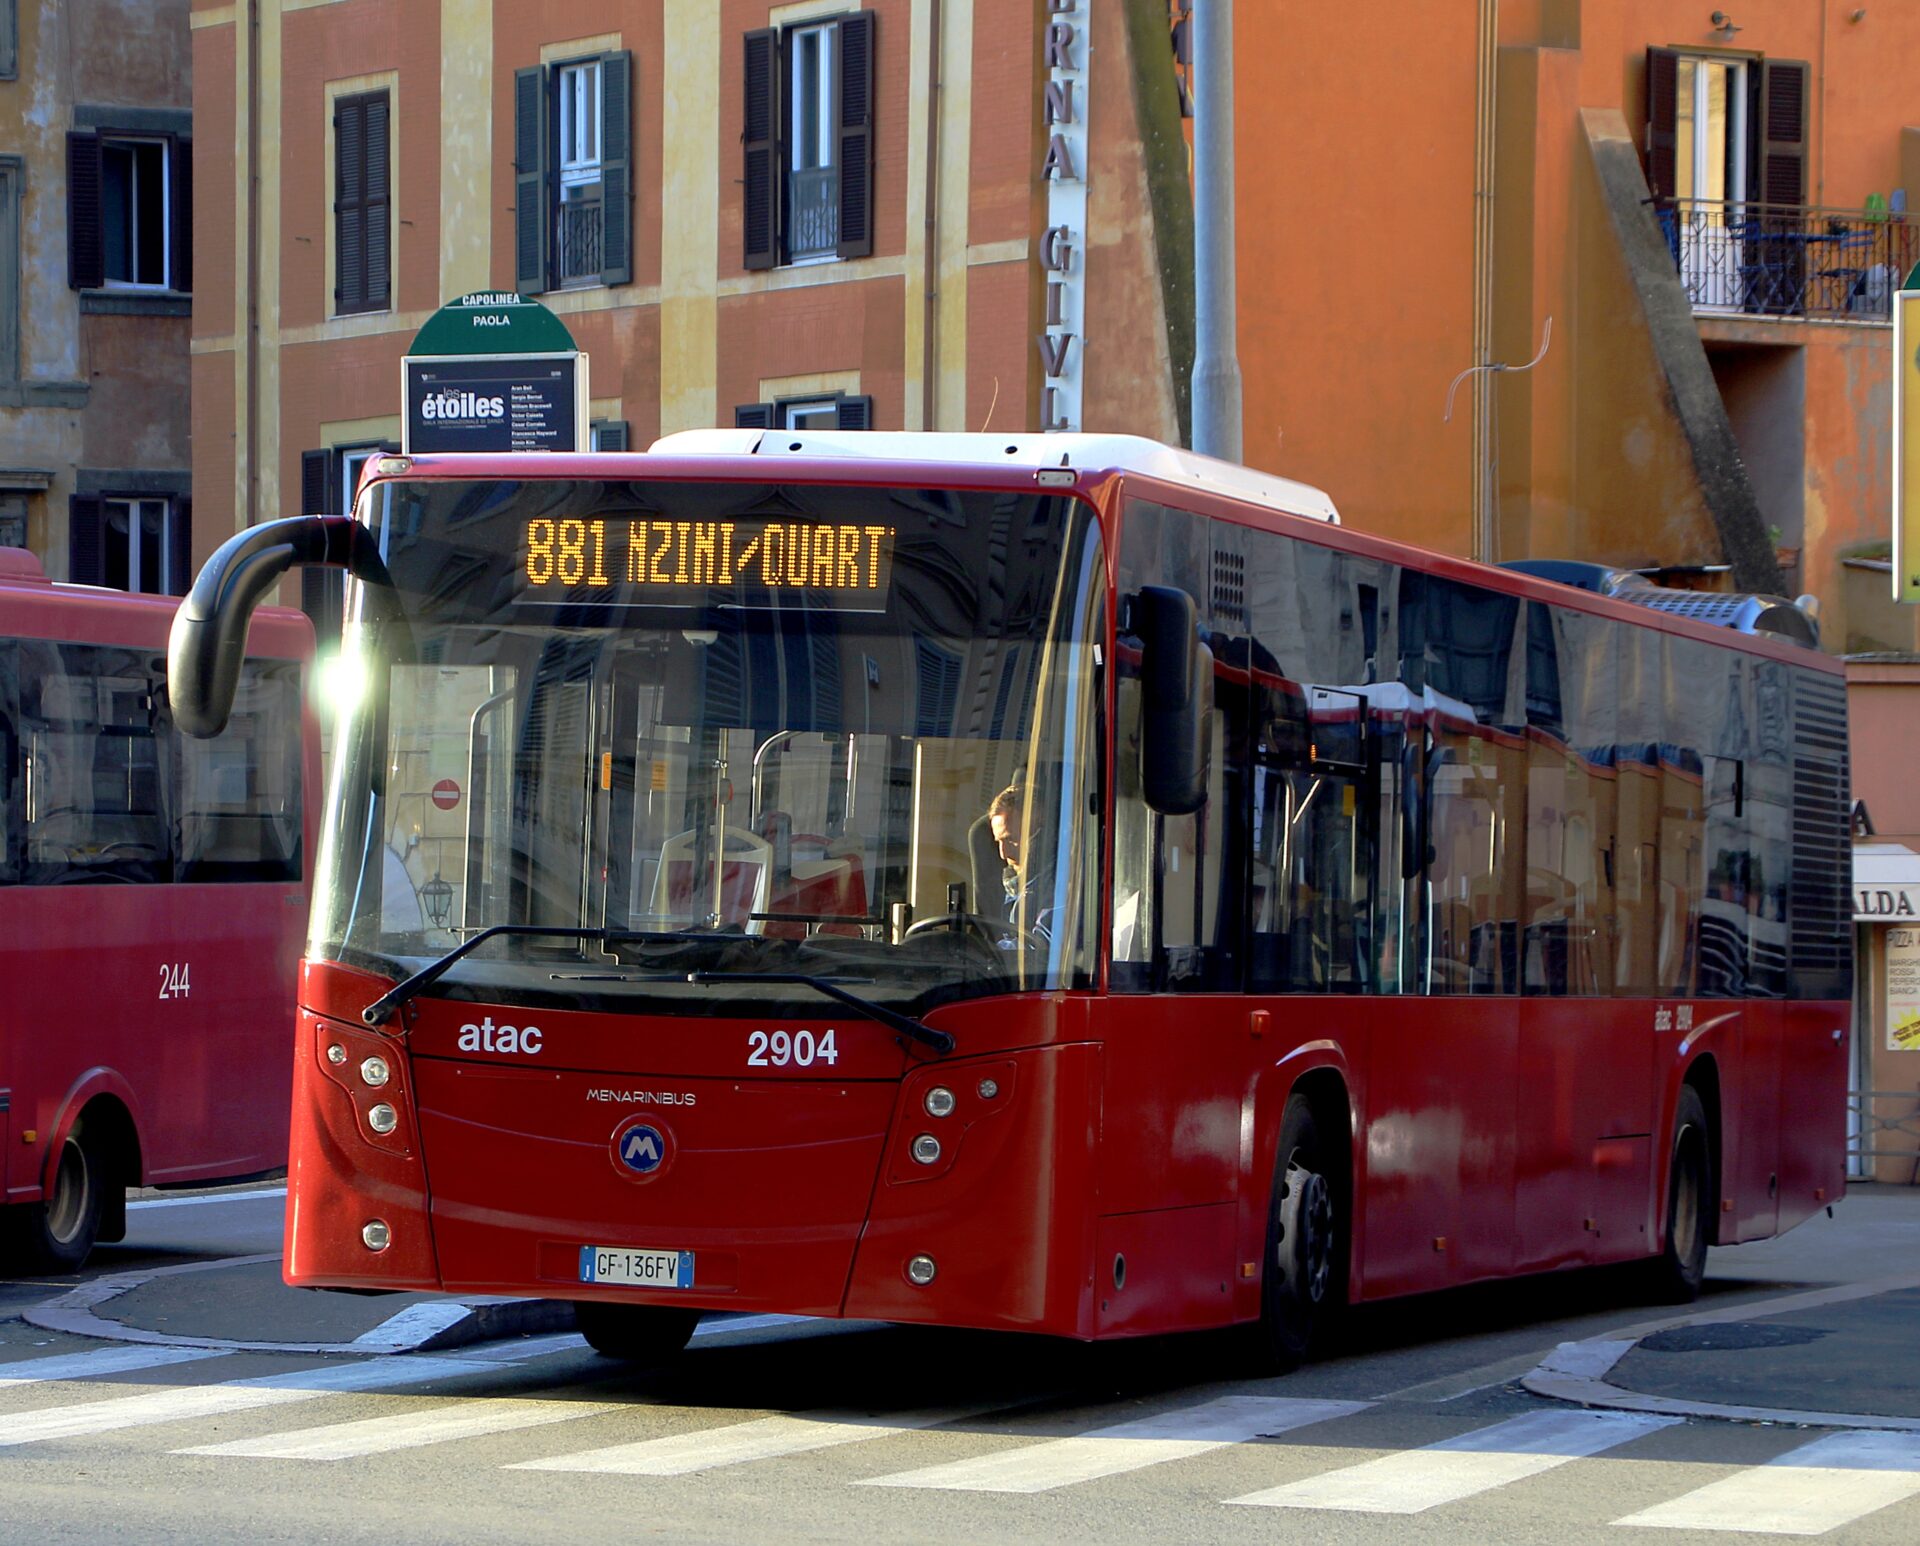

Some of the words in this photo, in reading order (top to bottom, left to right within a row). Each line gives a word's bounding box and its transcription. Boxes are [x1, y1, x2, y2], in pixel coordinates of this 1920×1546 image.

[462, 292, 521, 306] CAPOLINEA
[473, 314, 511, 327] PAOLA
[421, 392, 504, 419] étoiles
[443, 387, 461, 400] les
[526, 518, 608, 587] 881
[627, 521, 896, 589] NZINI/QUART
[1887, 930, 1914, 948] PIZZA
[158, 963, 191, 999] 244
[458, 1017, 543, 1054] atac
[747, 1029, 838, 1067] 2904
[586, 1088, 697, 1106] MENARINIBUS
[624, 1135, 659, 1160] M
